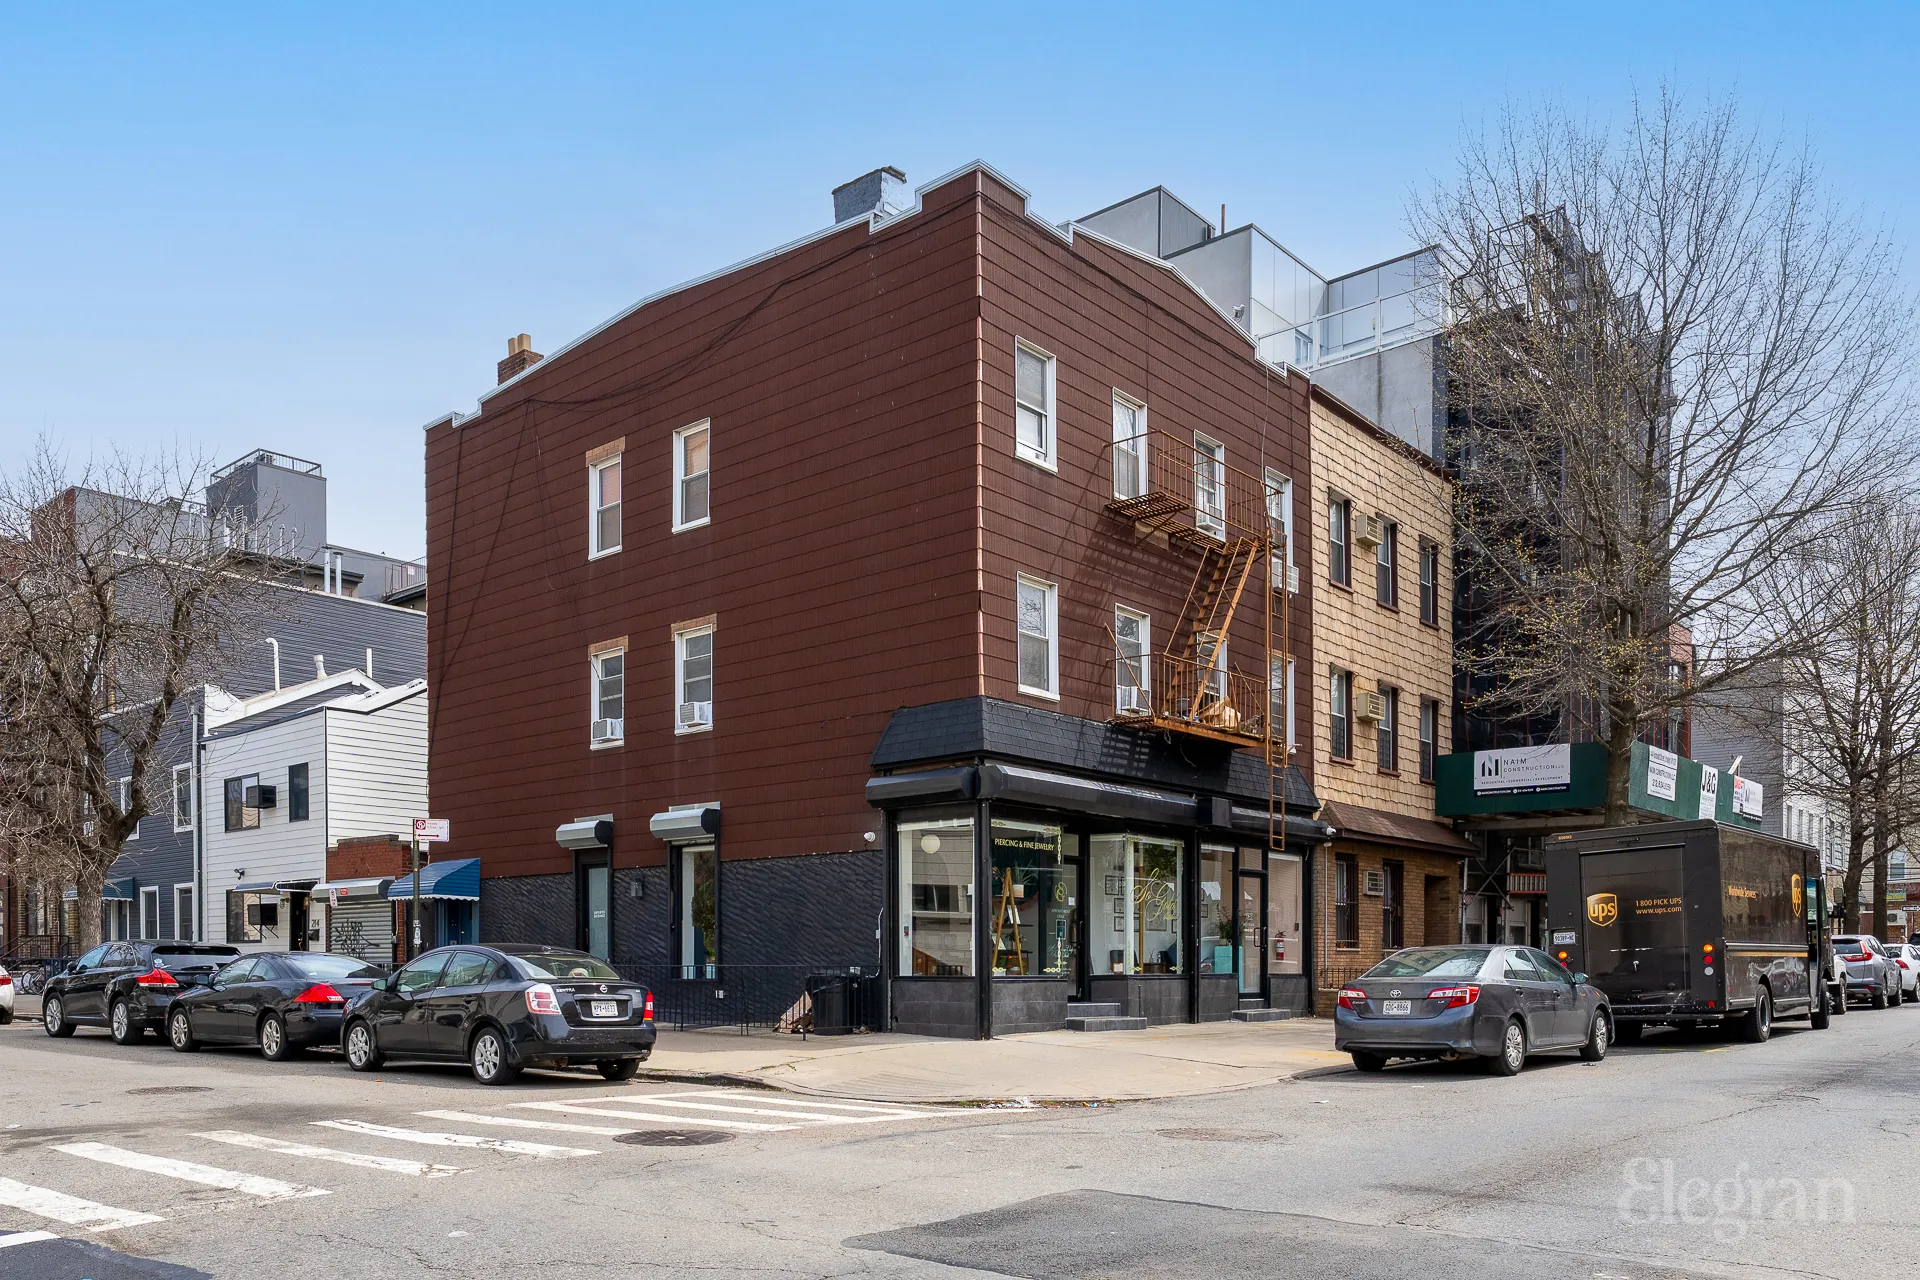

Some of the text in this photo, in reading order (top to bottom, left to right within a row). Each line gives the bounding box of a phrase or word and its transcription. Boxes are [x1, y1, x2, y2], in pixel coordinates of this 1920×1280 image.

[1503, 758, 1527, 766] NAIM
[1503, 764, 1555, 773] CONSTRUCTION
[1701, 770, 1717, 795] J&G
[994, 838, 1055, 851] PIERCING & FINE JEWELRY
[1640, 899, 1652, 907] 800
[1653, 898, 1668, 906] PICK
[1669, 897, 1682, 905] UPS
[1792, 887, 1801, 911] ups
[1589, 903, 1616, 922] ups
[1636, 906, 1682, 915] www.ups.com
[311, 919, 320, 928] 214
